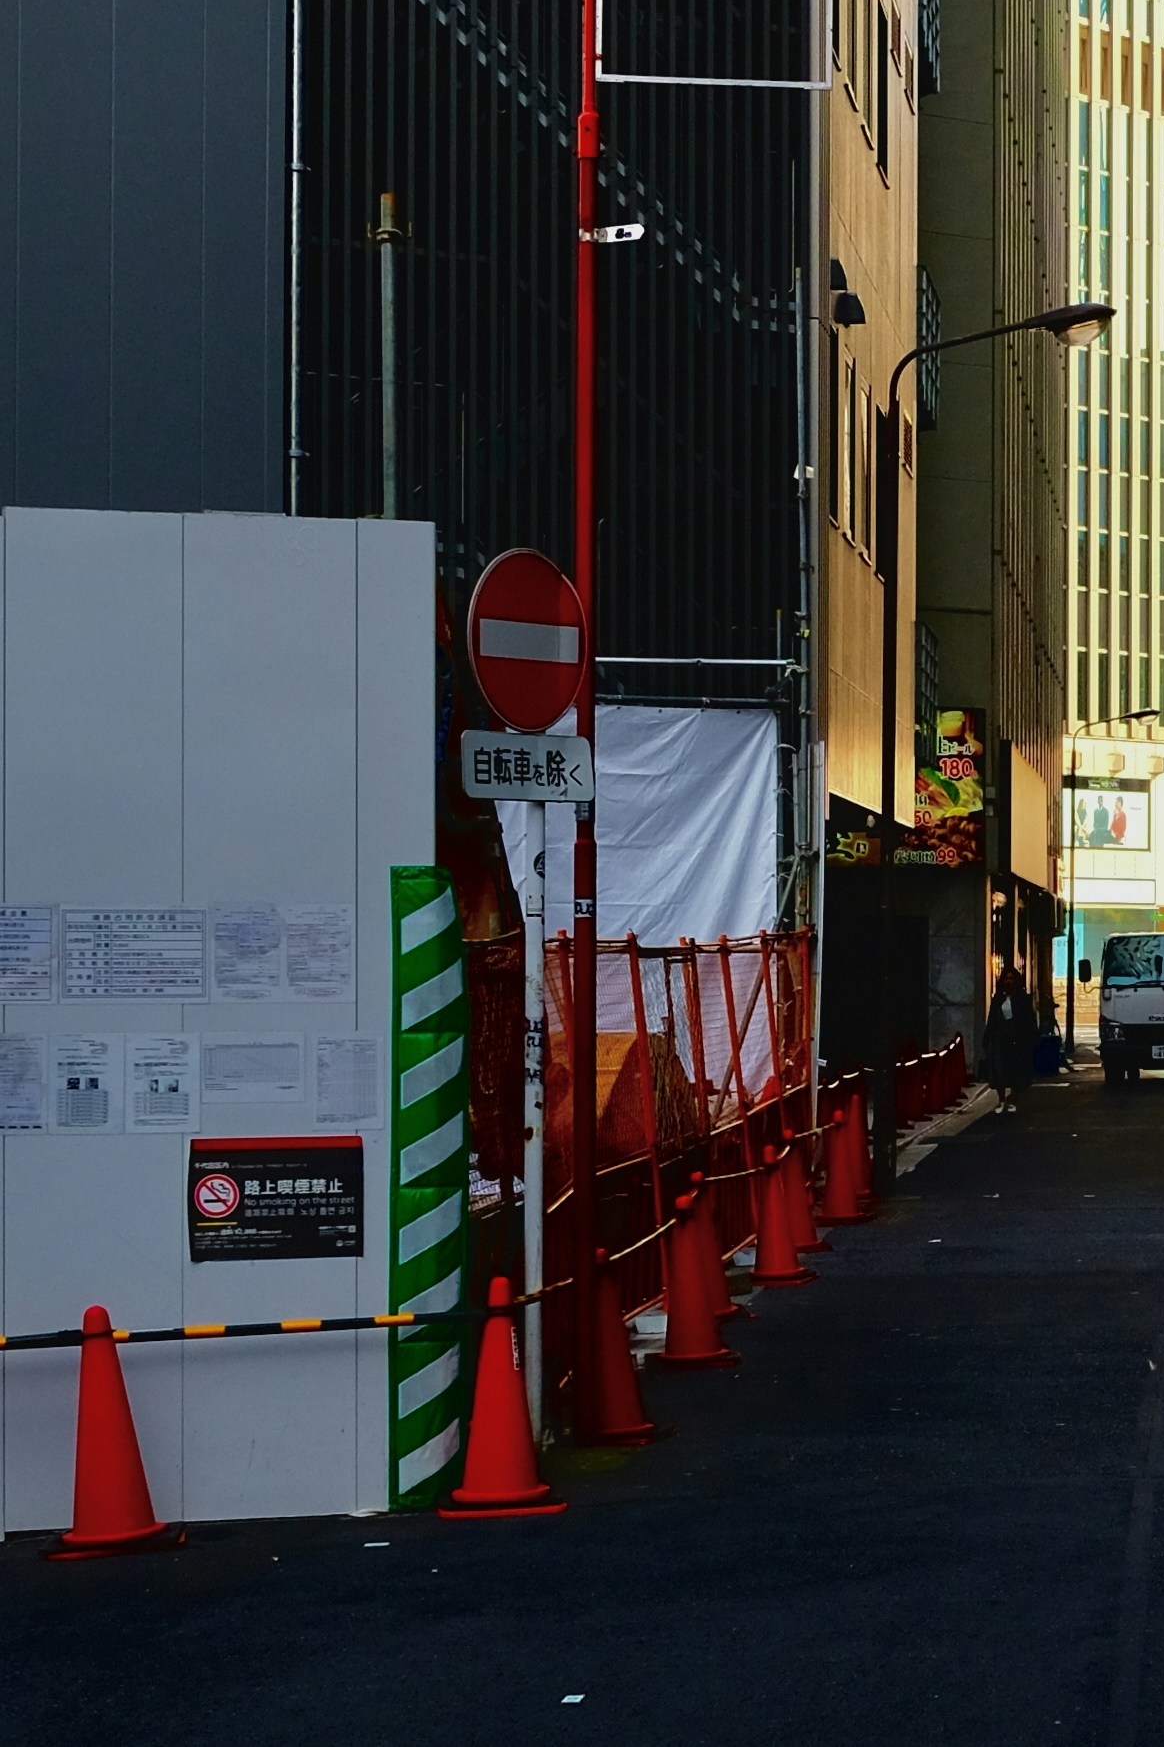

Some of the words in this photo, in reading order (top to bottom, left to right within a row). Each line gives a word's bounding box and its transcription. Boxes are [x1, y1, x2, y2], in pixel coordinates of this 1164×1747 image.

[474, 747, 583, 787] 自転車を除く
[244, 1178, 343, 1195] 路上喫煙禁止
[244, 1198, 257, 1206] No
[259, 1197, 296, 1207] smoking
[299, 1197, 311, 1205] on
[312, 1196, 327, 1204] the
[329, 1196, 355, 1204] street
